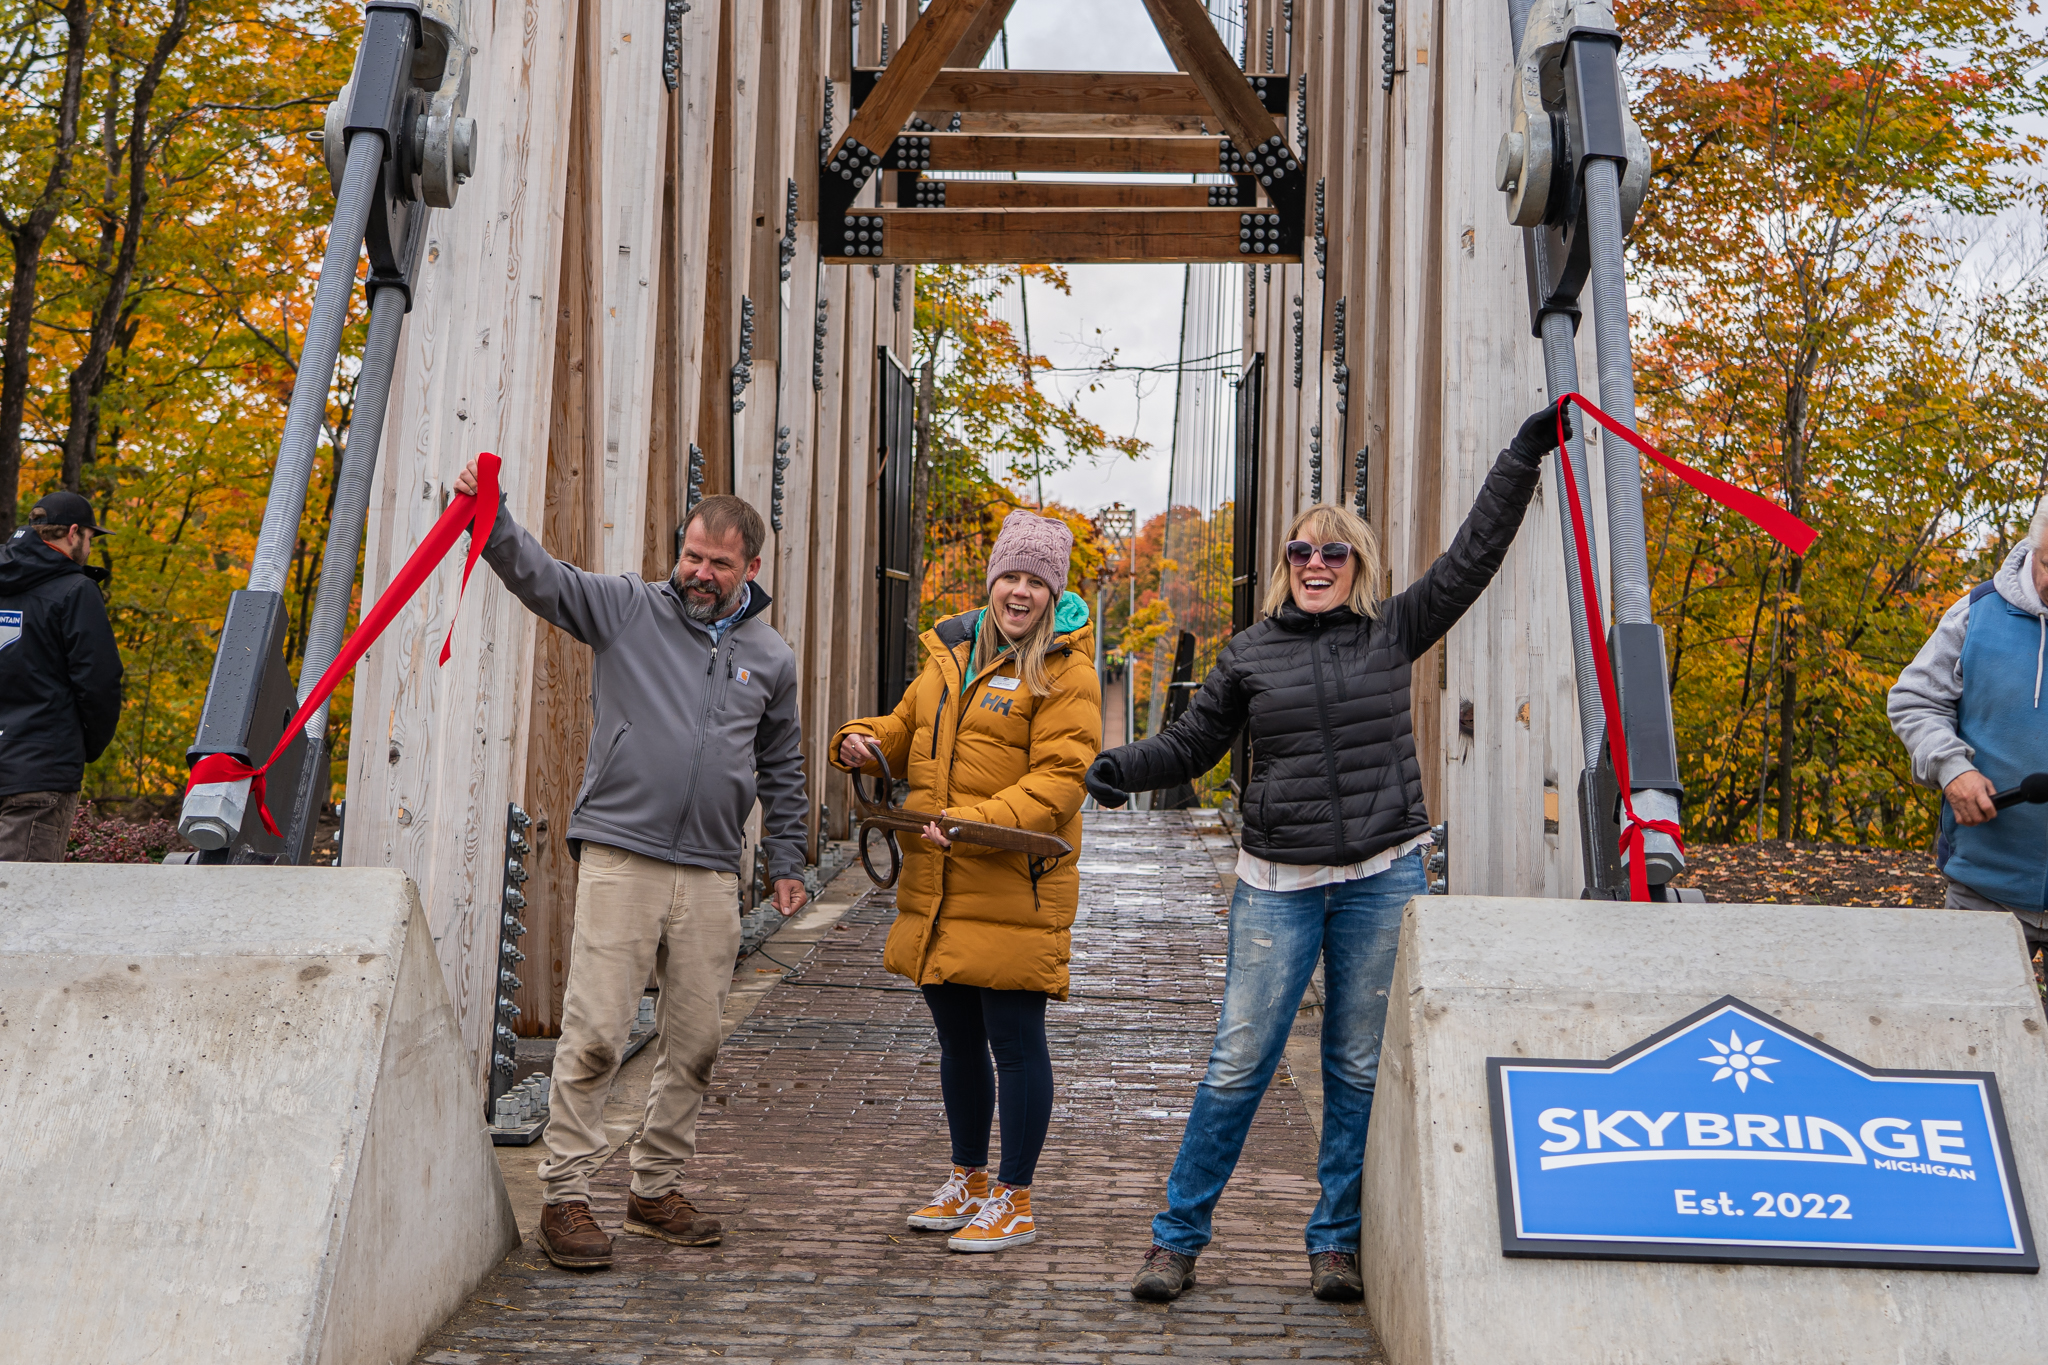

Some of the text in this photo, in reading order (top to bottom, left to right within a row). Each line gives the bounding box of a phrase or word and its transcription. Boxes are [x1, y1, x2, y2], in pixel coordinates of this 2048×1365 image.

[979, 692, 1014, 717] HH
[1537, 1107, 1973, 1168] SKYBRIDGE
[1872, 1158, 1976, 1181] MICHIGAN
[1674, 1189, 1853, 1220] Est. 2022
